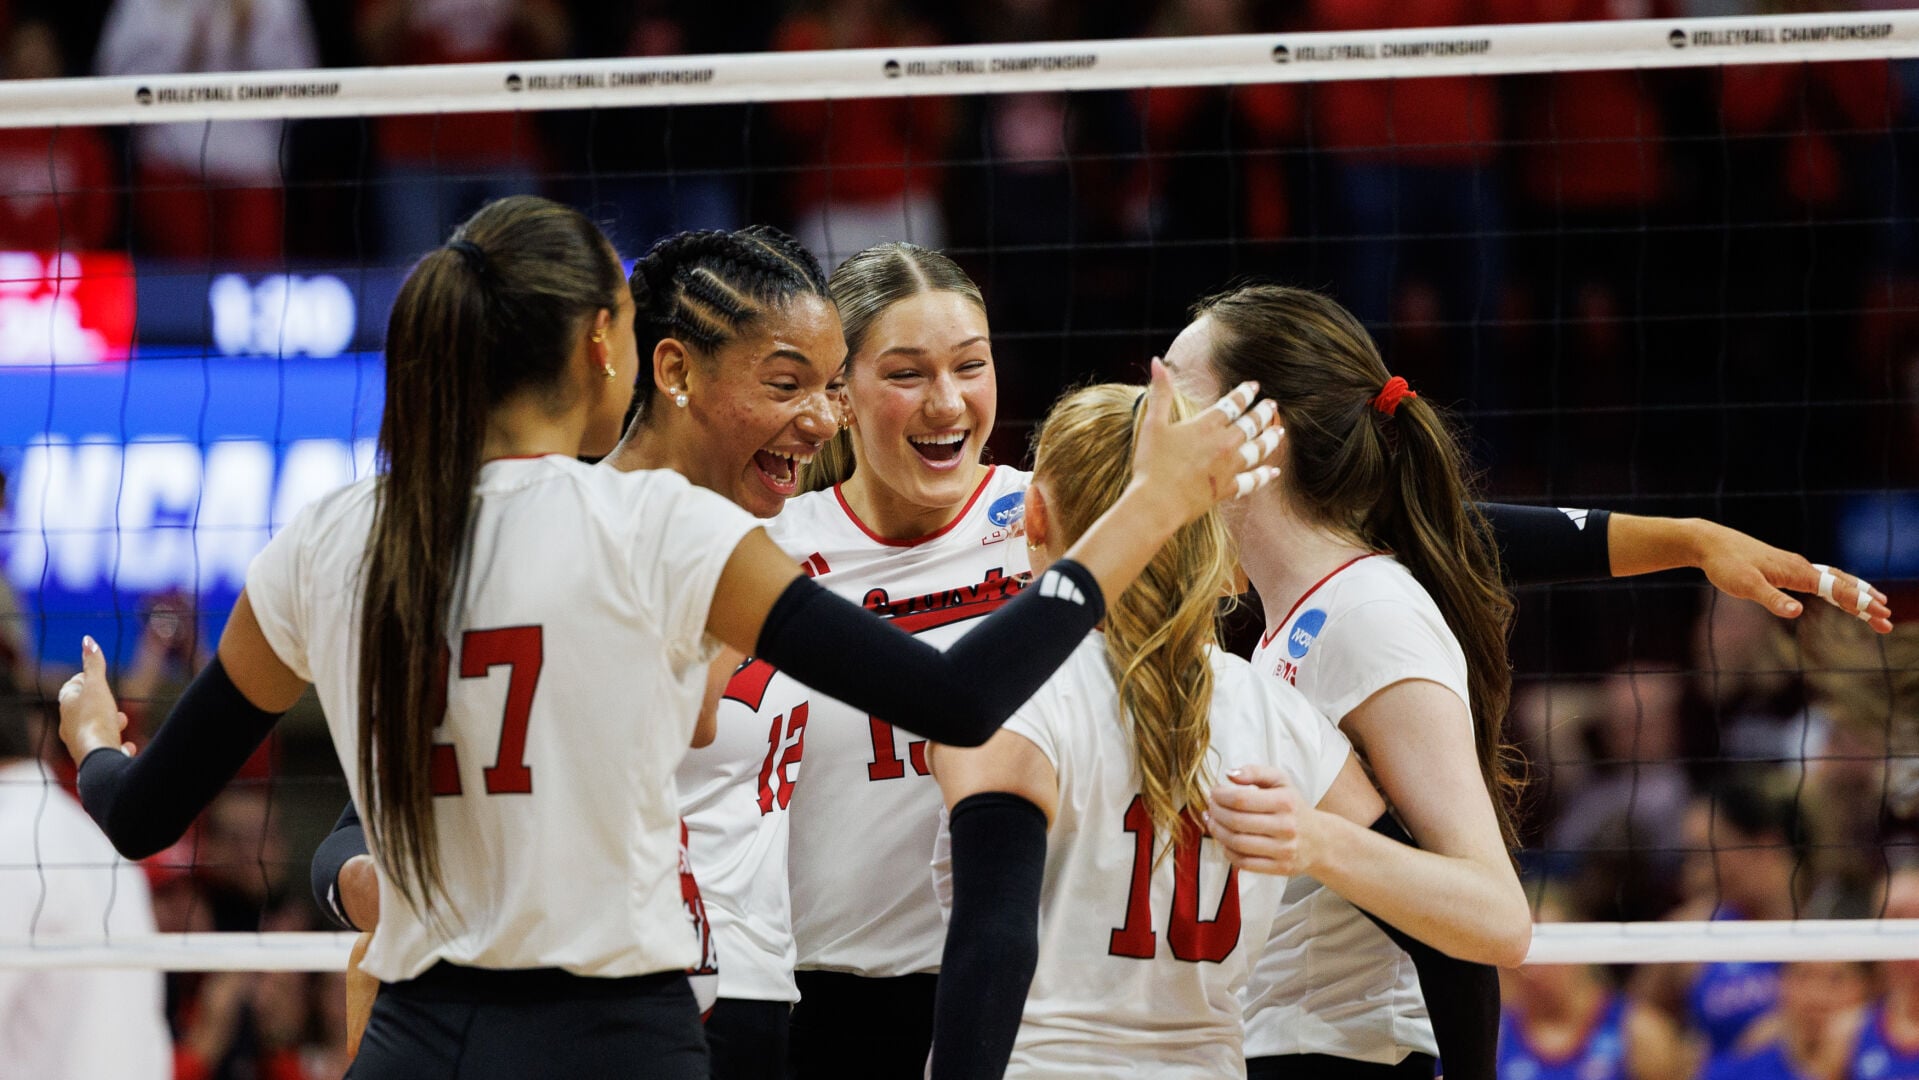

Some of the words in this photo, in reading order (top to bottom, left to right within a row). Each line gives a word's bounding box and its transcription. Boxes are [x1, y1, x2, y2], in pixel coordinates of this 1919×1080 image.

[1691, 28, 1776, 46] VOLLEYBALL
[1779, 24, 1893, 43] CHAMPIONSHIP
[1295, 44, 1376, 62] VOLLEYBALL
[1381, 40, 1492, 59] CHAMPIONSHIP
[906, 58, 986, 76] VOLLEYBALL
[989, 54, 1098, 72] CHAMPIONSHIP
[528, 73, 605, 90] VOLLEYBALL
[609, 69, 715, 88] CHAMPIONSHIP
[156, 87, 234, 102] VOLLEYBALL
[237, 83, 341, 100] CHAMPIONSHIP
[757, 700, 809, 816] 12
[1108, 793, 1242, 964] 10
